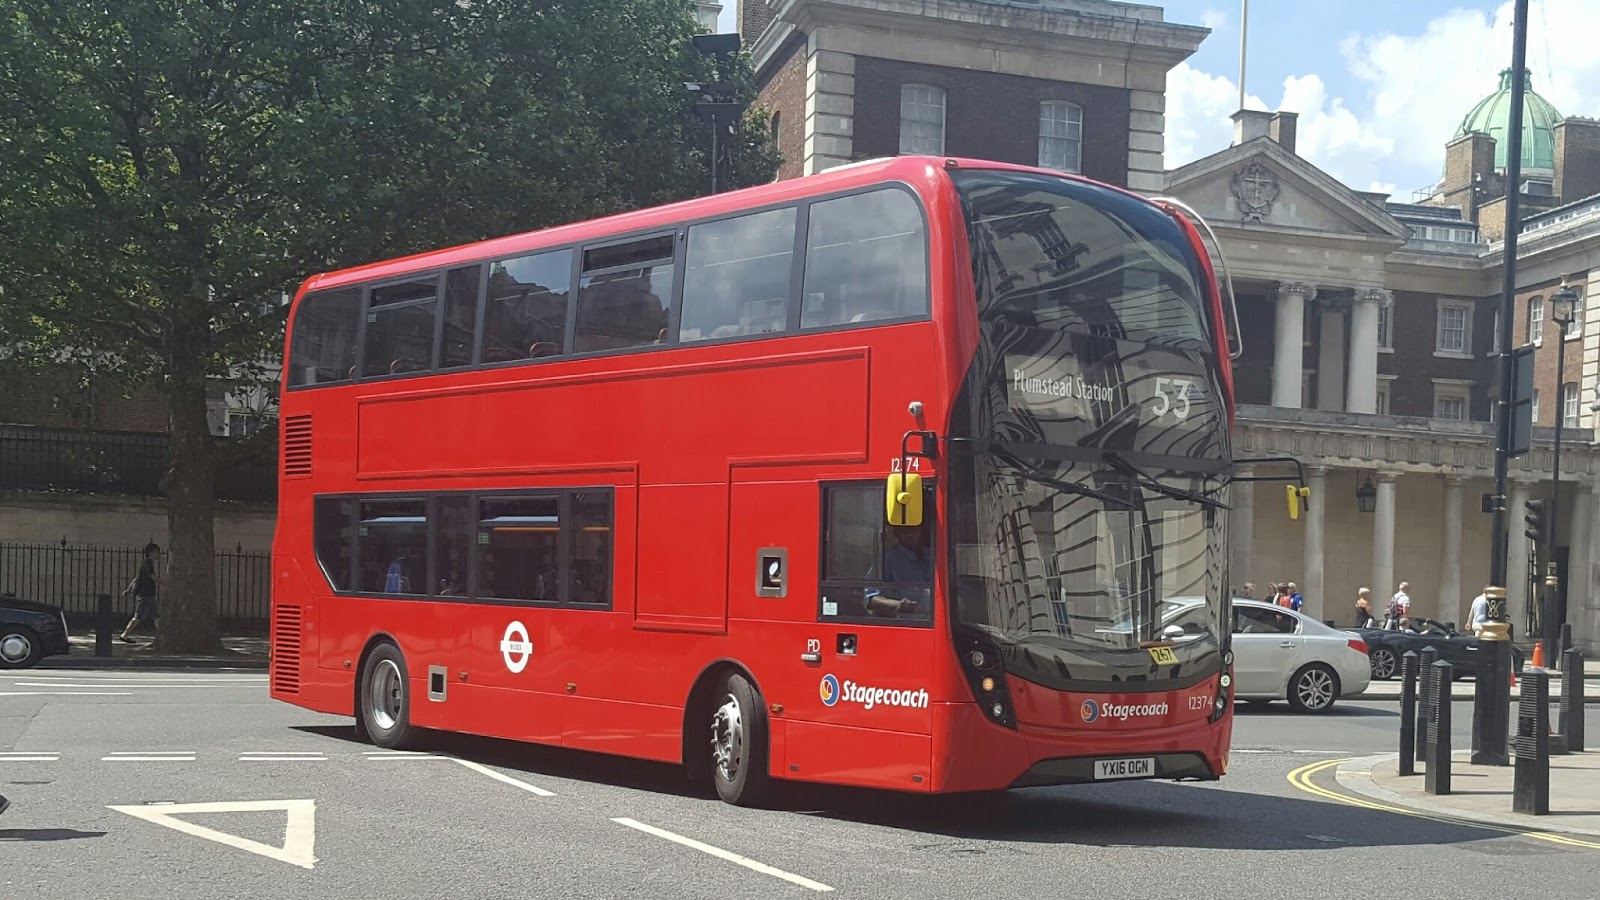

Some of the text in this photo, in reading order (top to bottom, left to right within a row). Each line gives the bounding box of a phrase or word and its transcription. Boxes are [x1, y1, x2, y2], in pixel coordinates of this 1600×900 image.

[1013, 369, 1114, 402] Plumstead Station
[1152, 377, 1191, 419] 53
[891, 457, 920, 472] 1274
[807, 639, 821, 653] PD
[1152, 648, 1174, 662] 267
[842, 680, 929, 709] Stagecoach
[1188, 696, 1214, 710] 12374
[1101, 702, 1169, 721] Stagecoach
[1102, 760, 1149, 776] YX16 OGN
